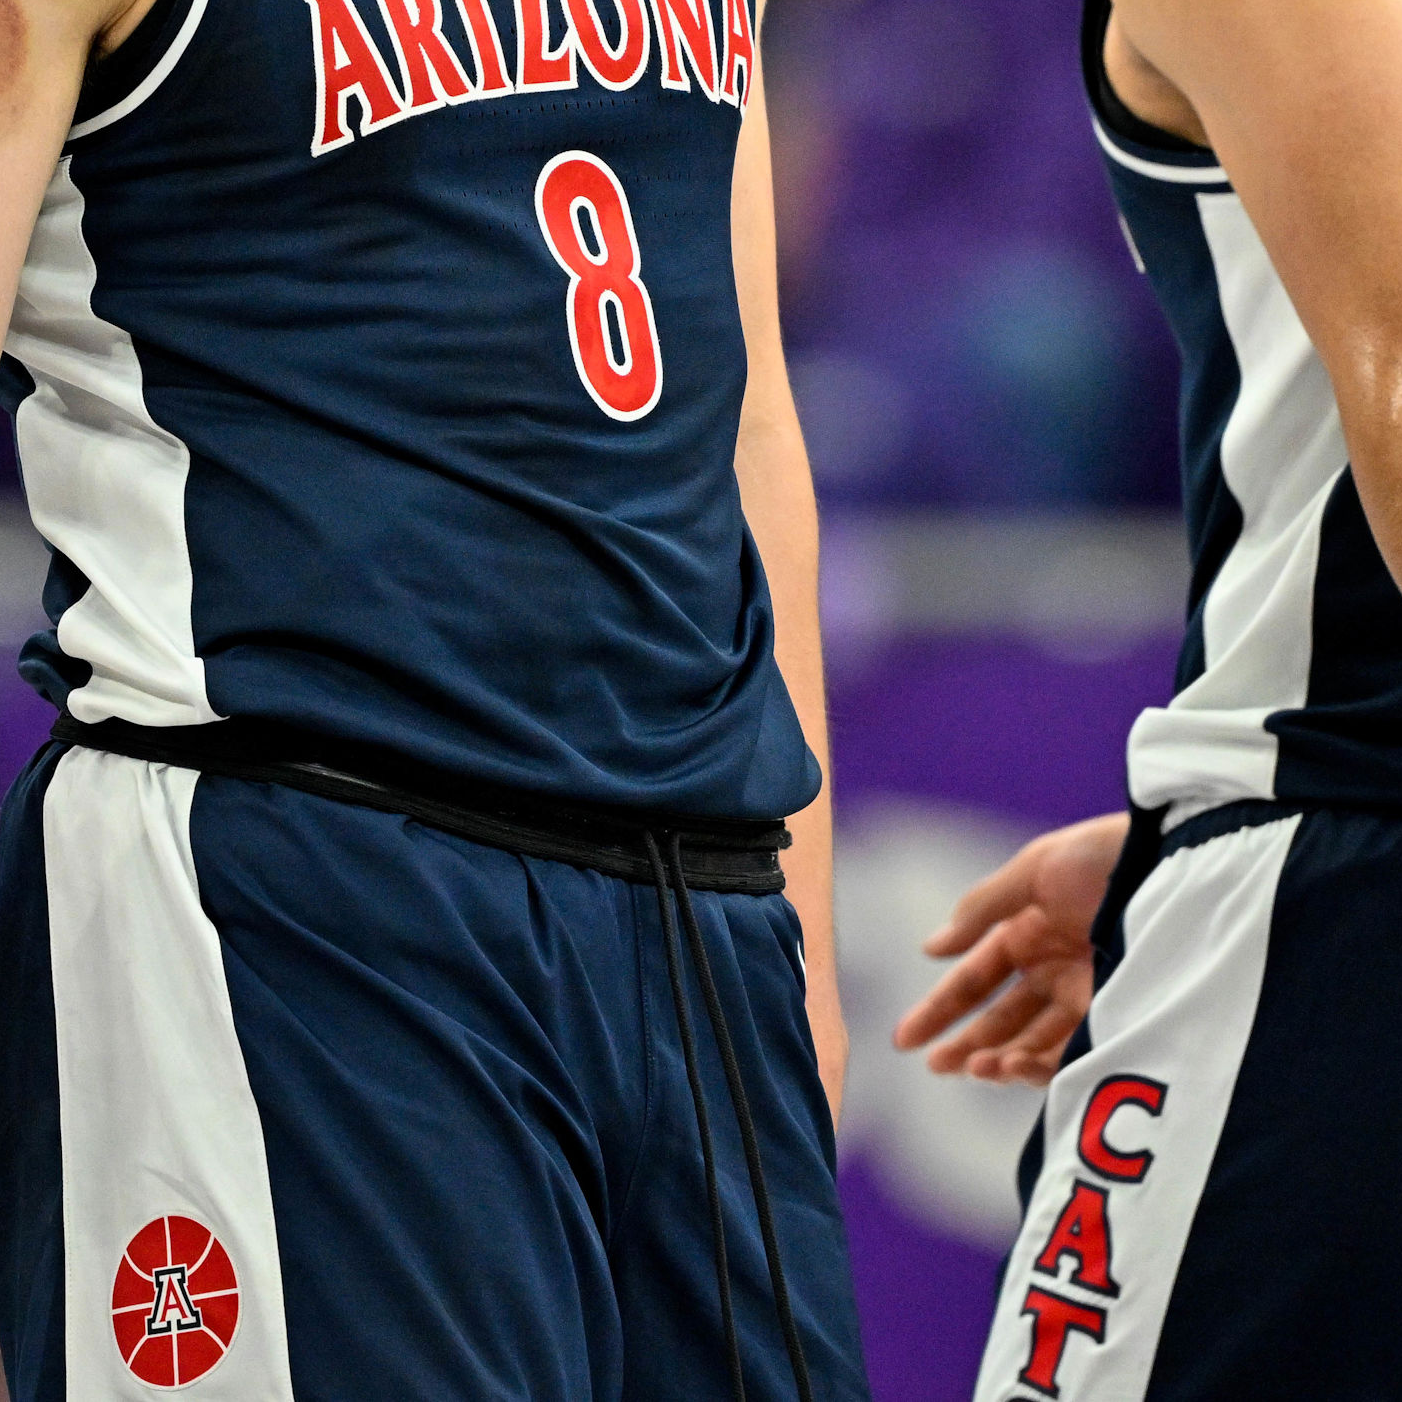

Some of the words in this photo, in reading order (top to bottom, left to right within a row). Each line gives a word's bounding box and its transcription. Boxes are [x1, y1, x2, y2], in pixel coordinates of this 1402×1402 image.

[534, 149, 664, 423] 8
[145, 1264, 203, 1337] A
[1002, 1073, 1169, 1402] CAT
